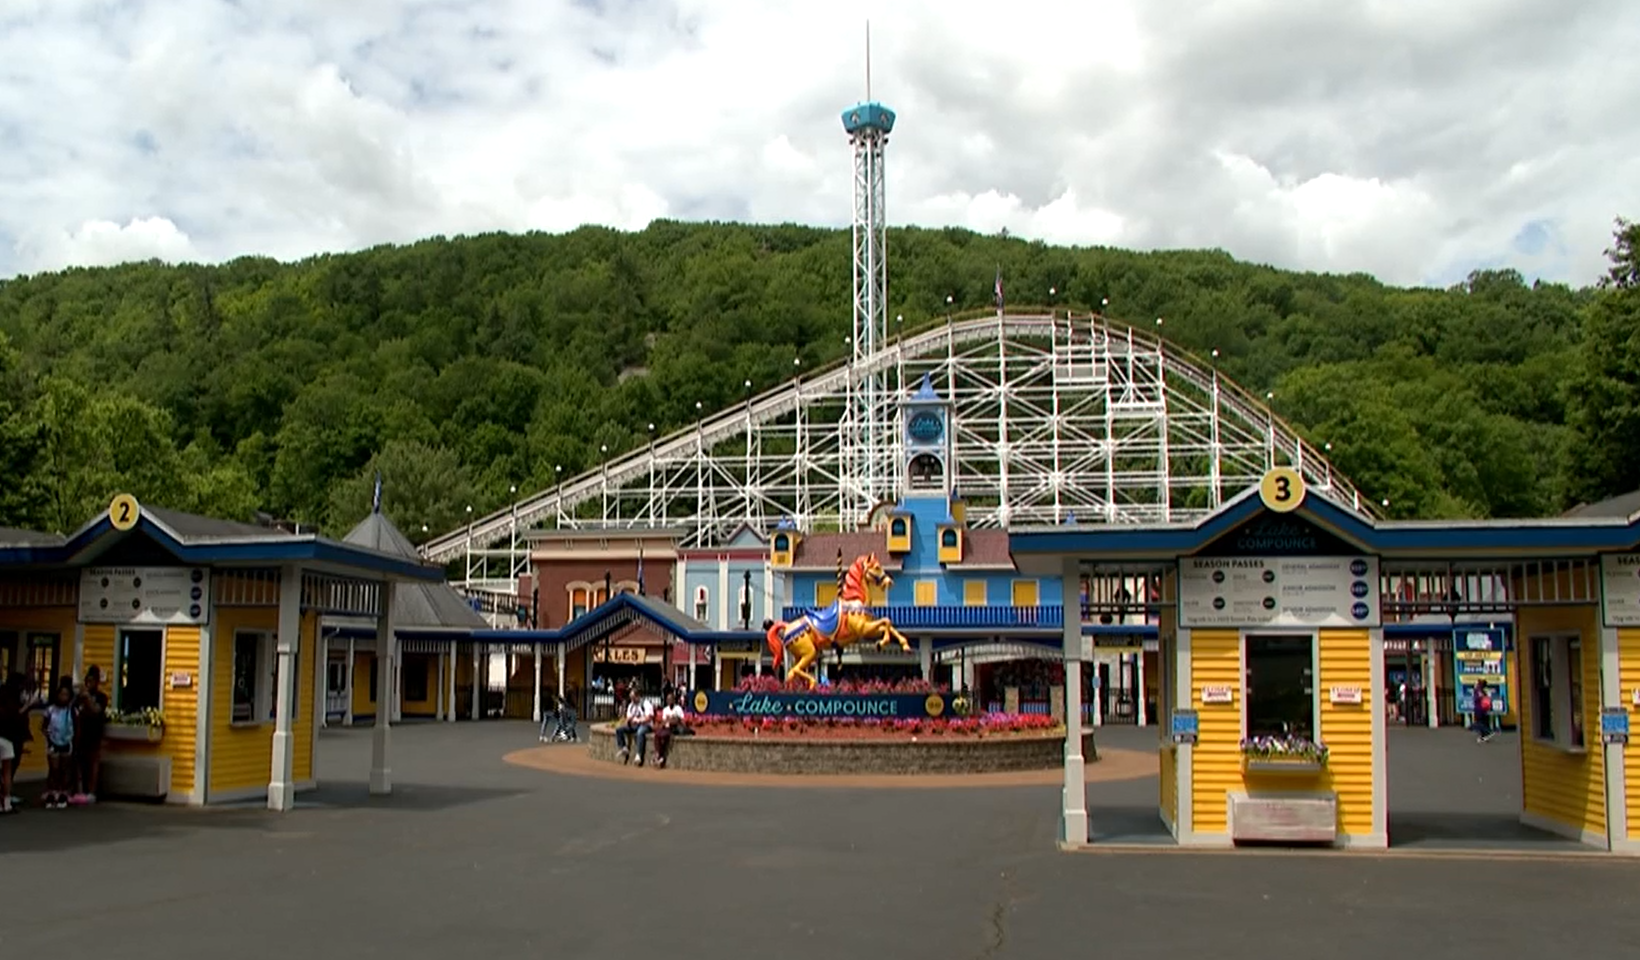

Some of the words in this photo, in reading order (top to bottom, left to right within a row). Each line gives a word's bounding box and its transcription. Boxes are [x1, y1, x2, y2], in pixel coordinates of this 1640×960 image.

[1275, 476, 1291, 501] 3
[119, 502, 129, 522] 2
[1254, 519, 1300, 536] Lake
[1237, 537, 1317, 550] COMPOUNCE
[1193, 560, 1230, 568] SEASON
[1232, 560, 1264, 568] PASSES
[734, 692, 783, 713] Lake
[795, 700, 897, 715] COMPOUNCE
